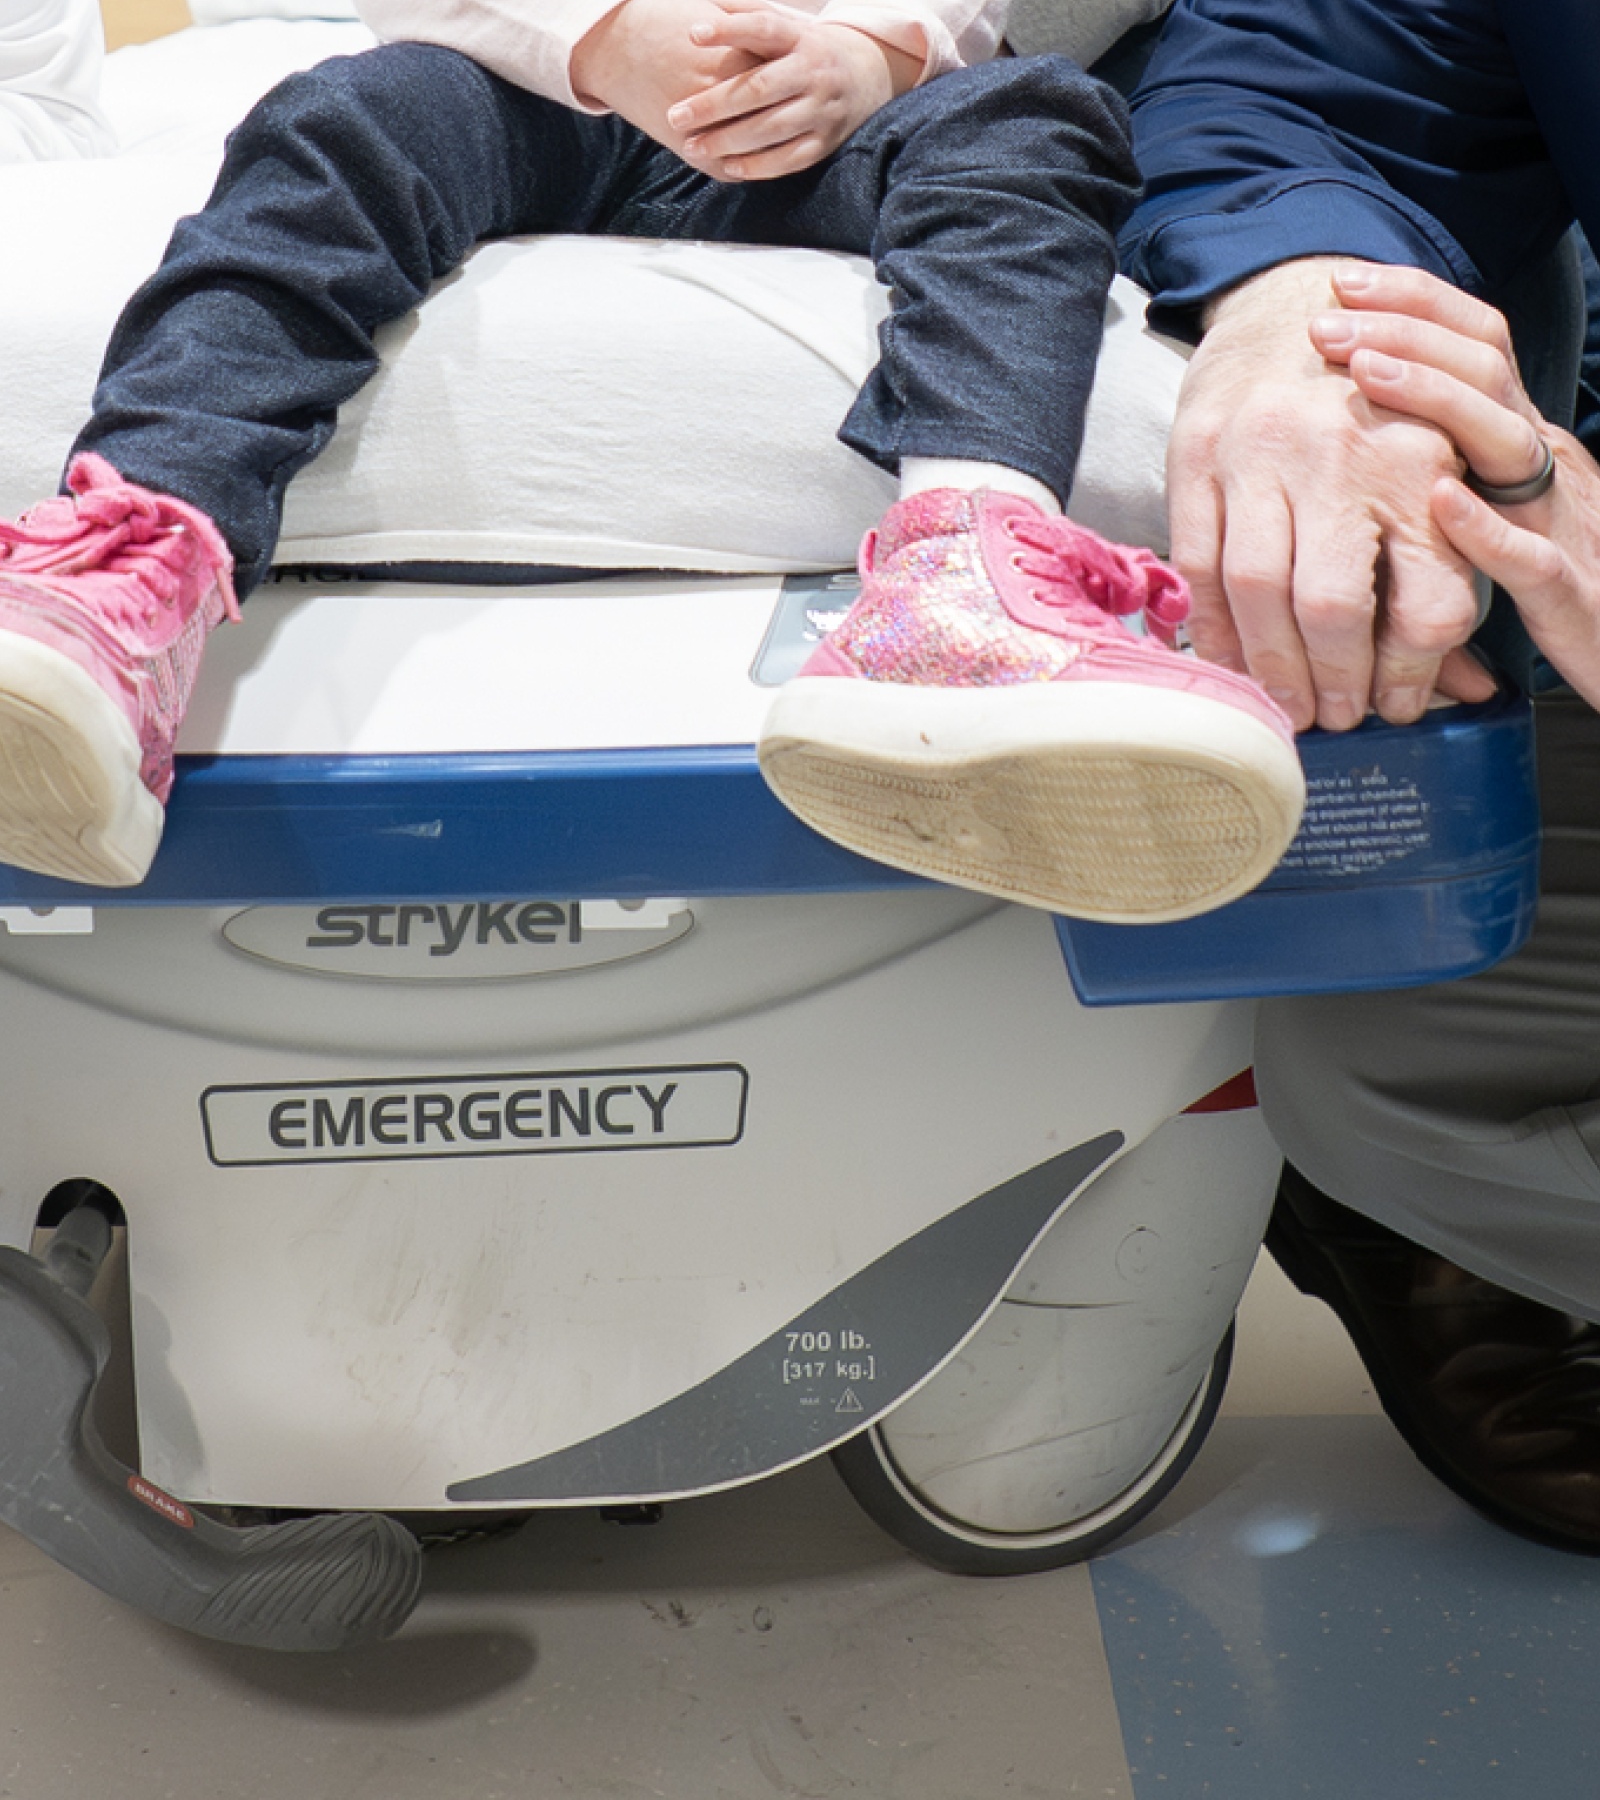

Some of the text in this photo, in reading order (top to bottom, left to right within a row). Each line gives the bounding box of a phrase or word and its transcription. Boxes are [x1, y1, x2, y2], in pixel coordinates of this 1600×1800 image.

[268, 1082, 679, 1150] EMERGENCY
[785, 1329, 872, 1352] 700 lb.
[782, 1354, 875, 1385] [317 kg.]
